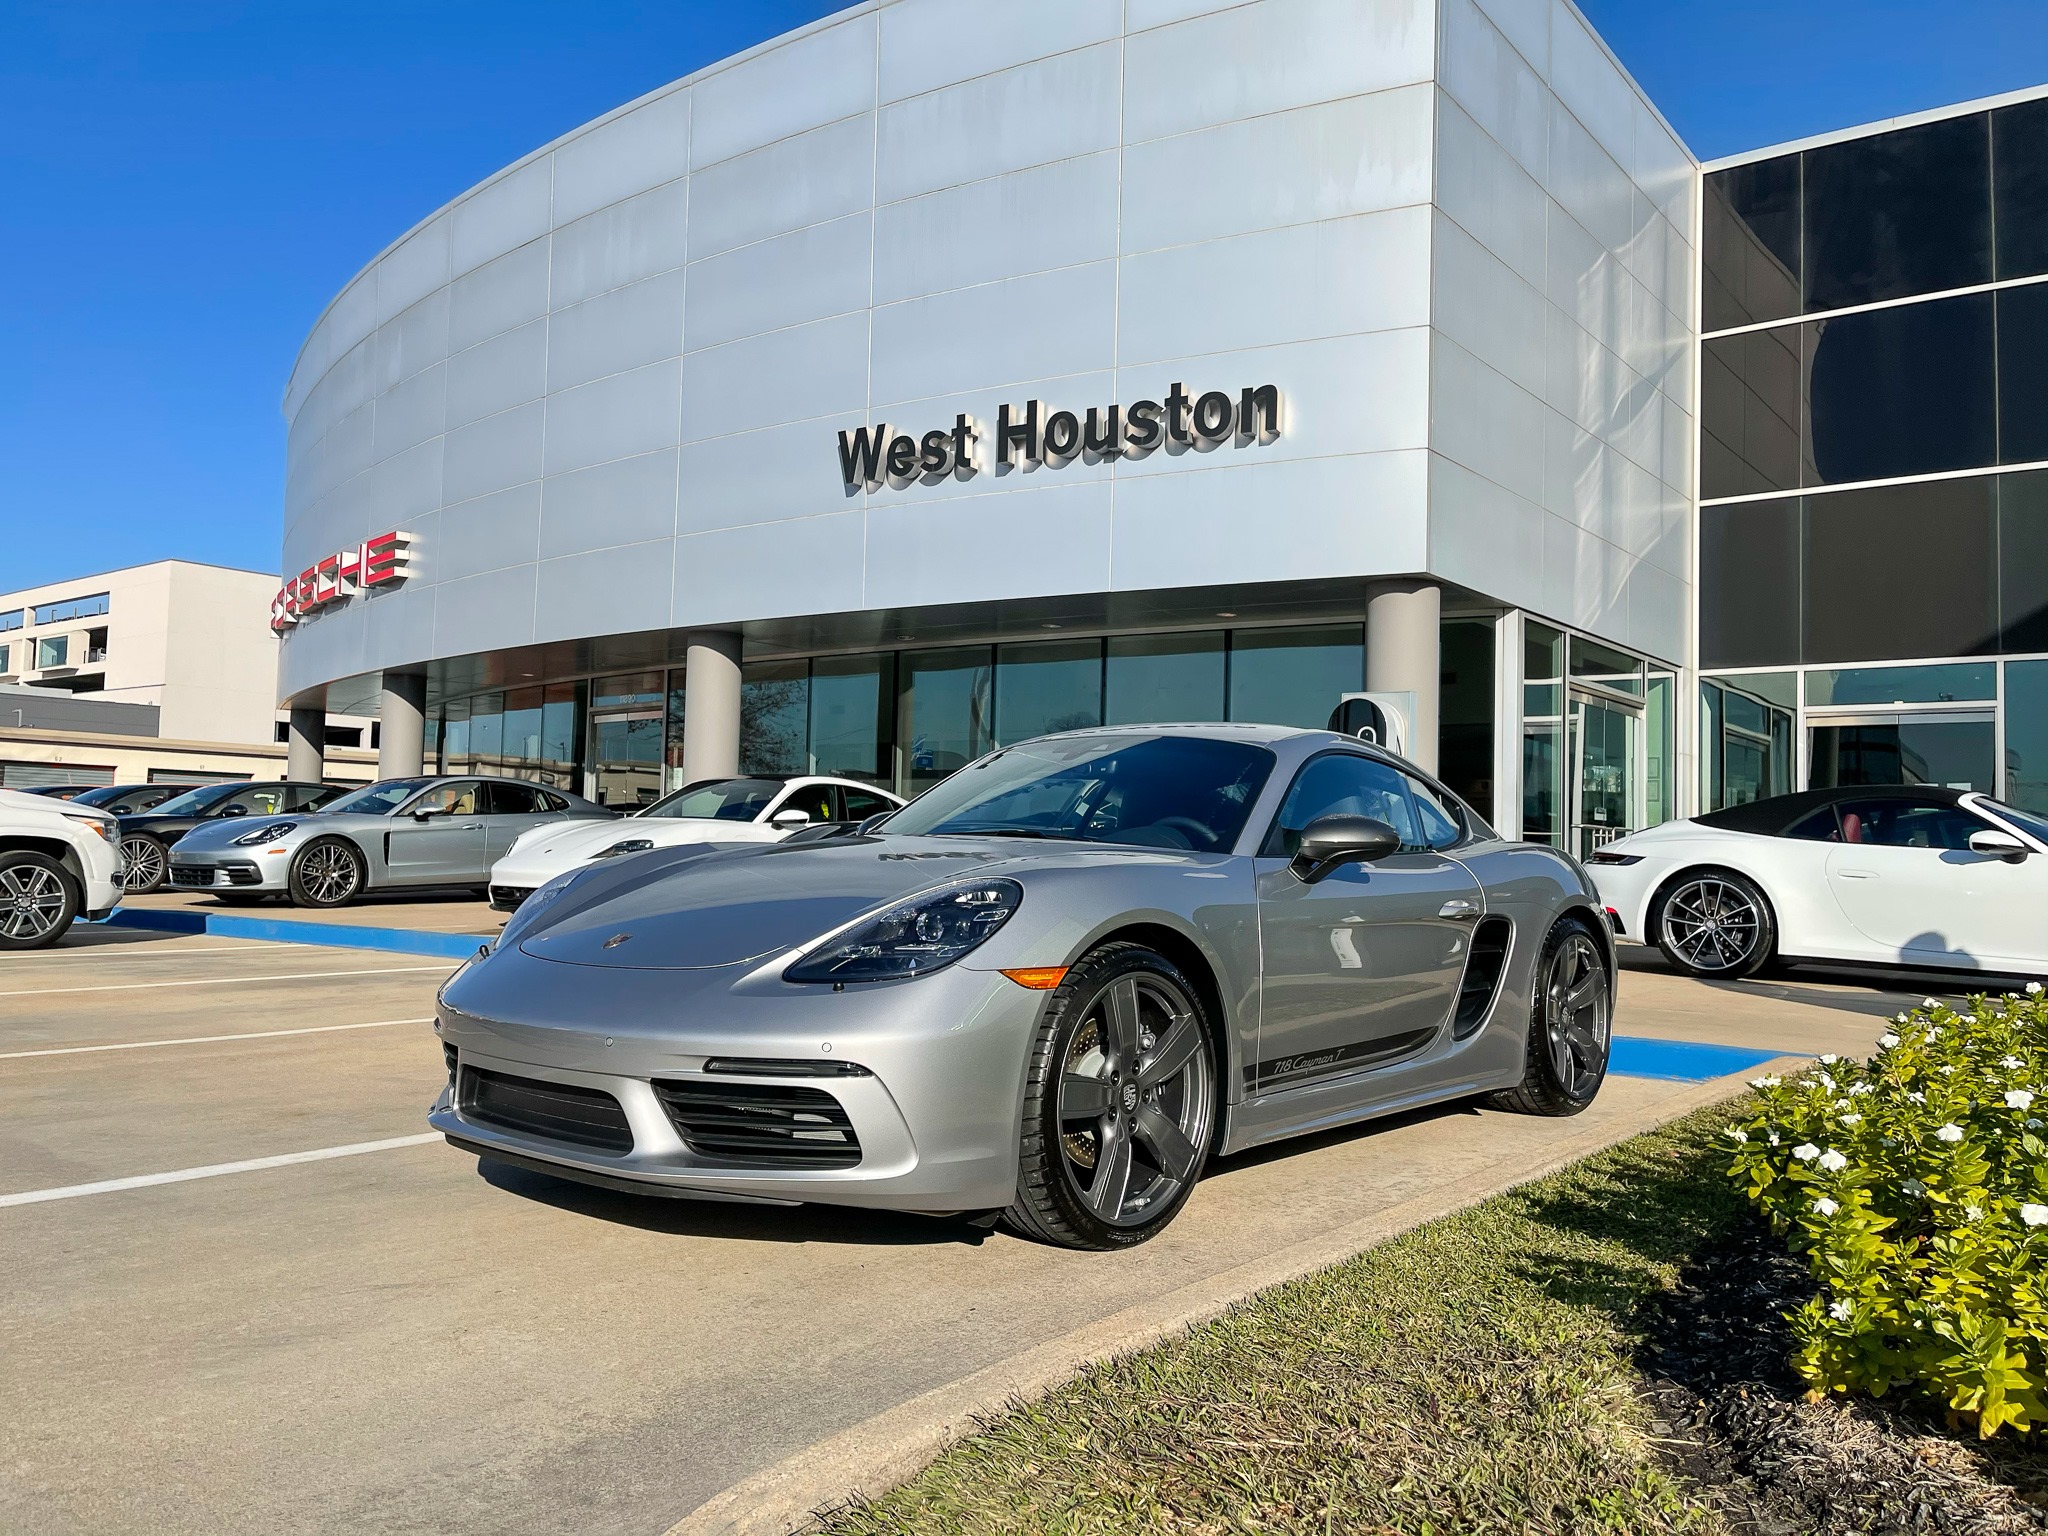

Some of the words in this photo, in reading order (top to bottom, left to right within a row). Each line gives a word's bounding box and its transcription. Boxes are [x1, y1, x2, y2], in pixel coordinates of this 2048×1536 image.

[838, 413, 977, 487] West
[997, 381, 1280, 468] Houston
[1274, 1059, 1293, 1074] 718
[1292, 1053, 1334, 1075] Cayman
[1335, 1048, 1346, 1061] T
